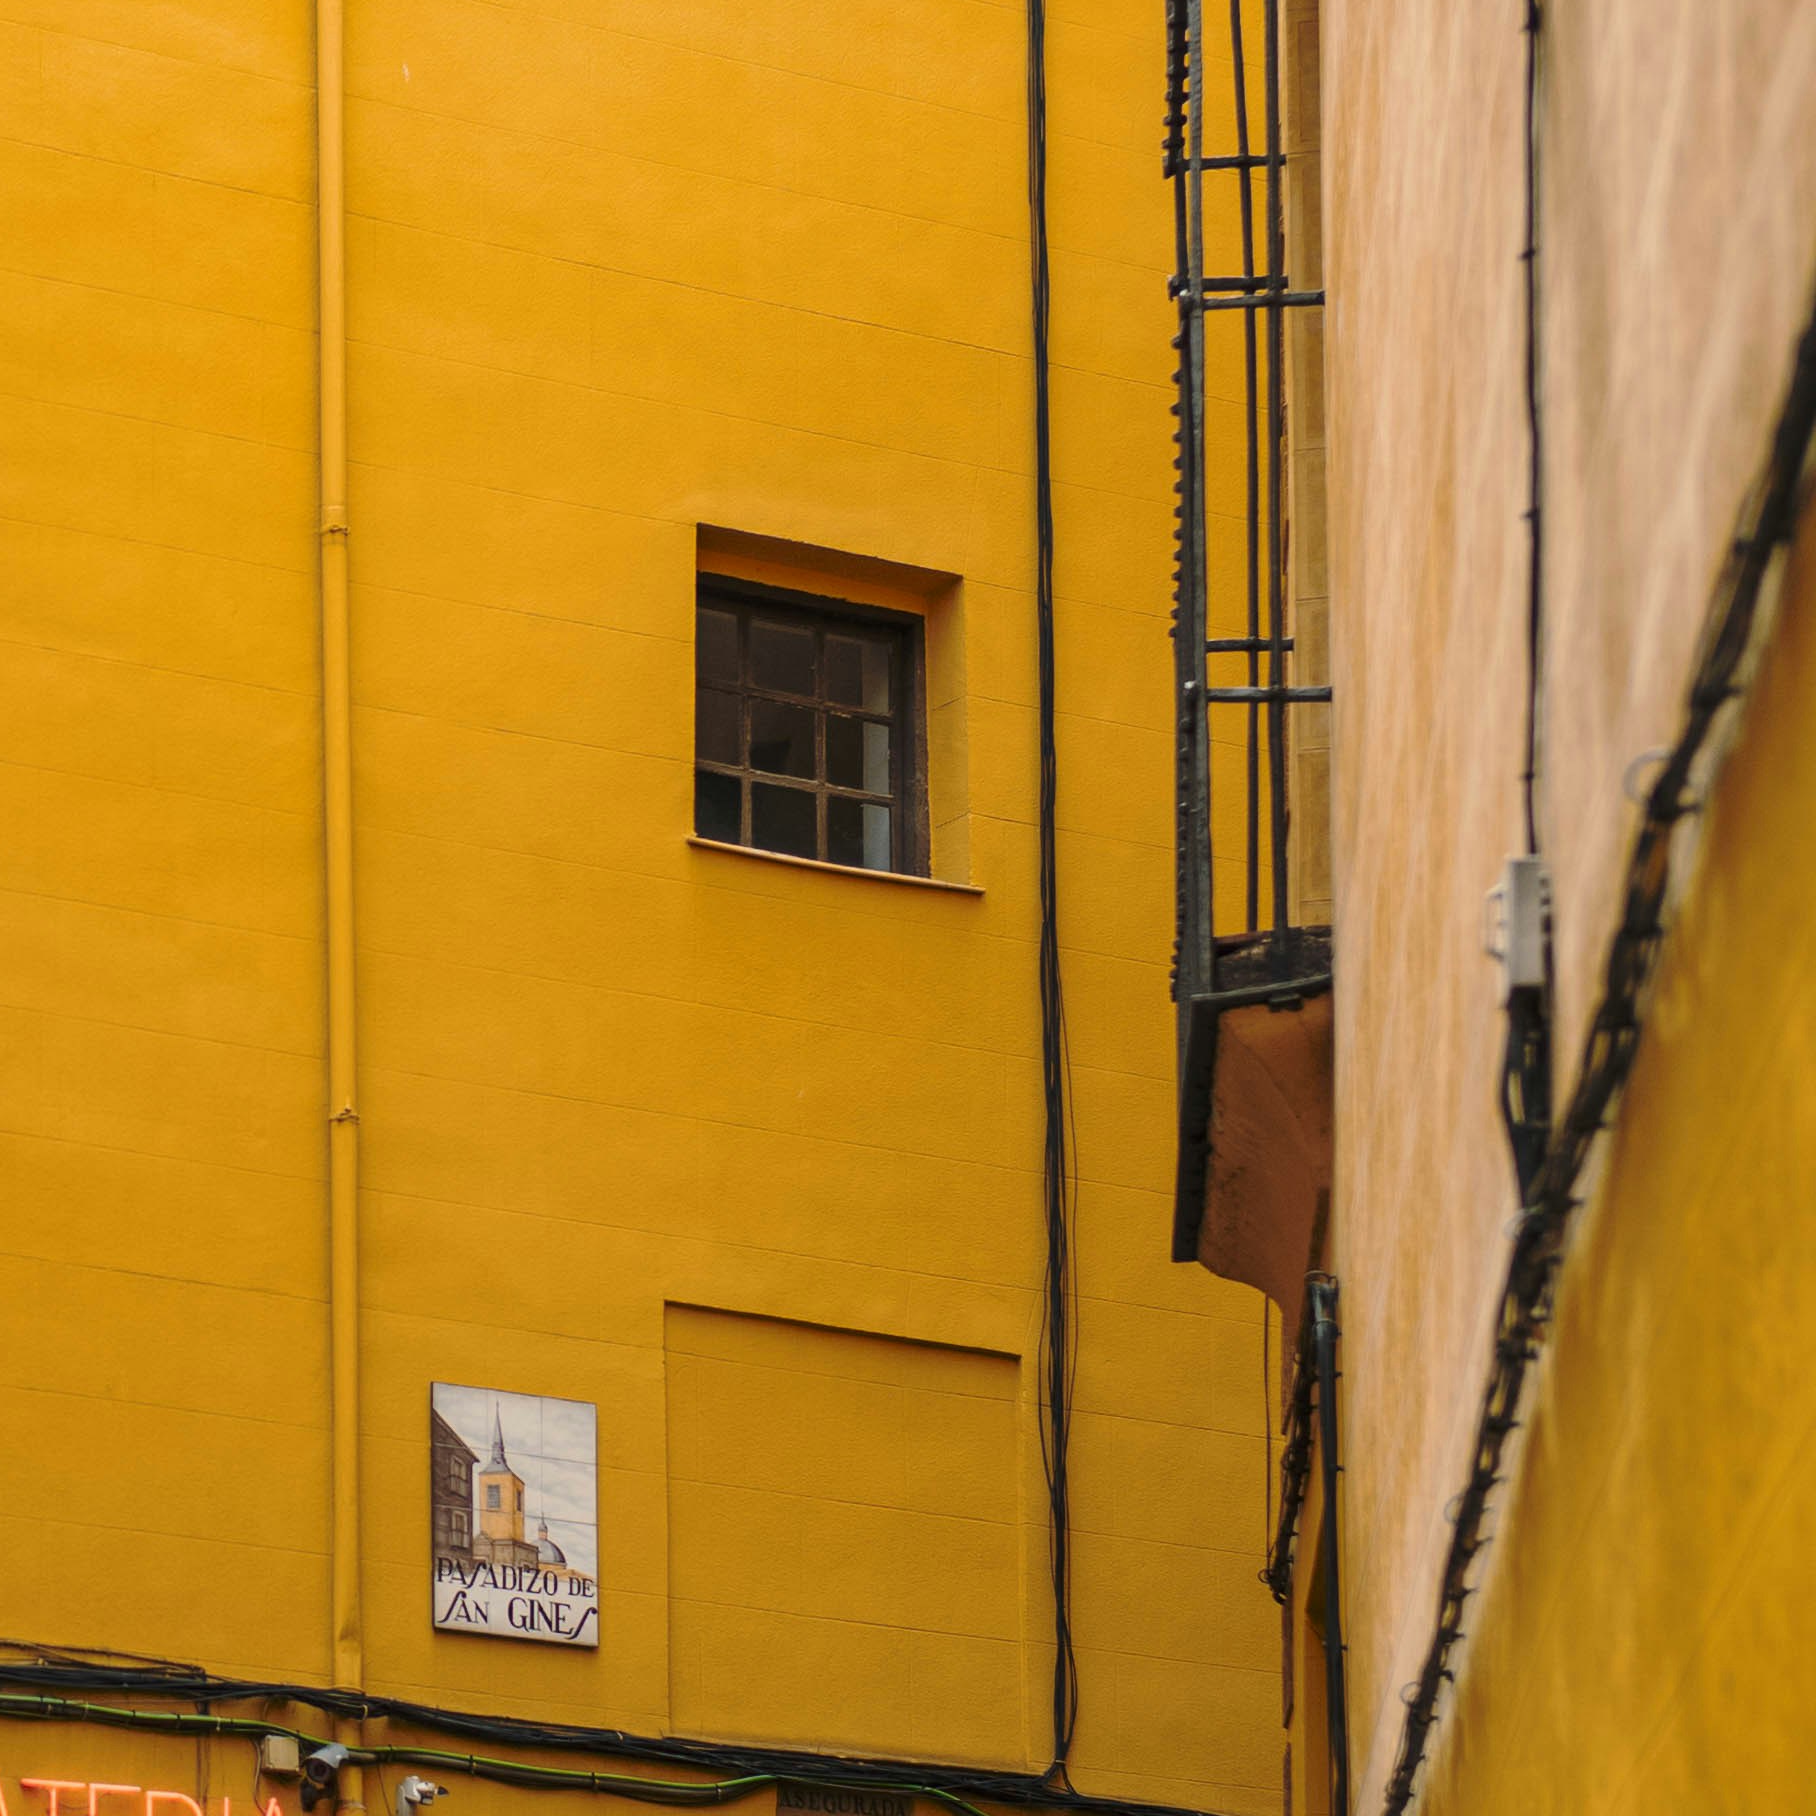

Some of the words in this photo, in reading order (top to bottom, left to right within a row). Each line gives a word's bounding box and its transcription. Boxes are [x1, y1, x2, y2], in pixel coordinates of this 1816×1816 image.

[437, 1557, 558, 1596] PASADIZO
[567, 1576, 595, 1598] DE
[437, 1590, 489, 1624] SAN
[507, 1597, 598, 1640] GINES
